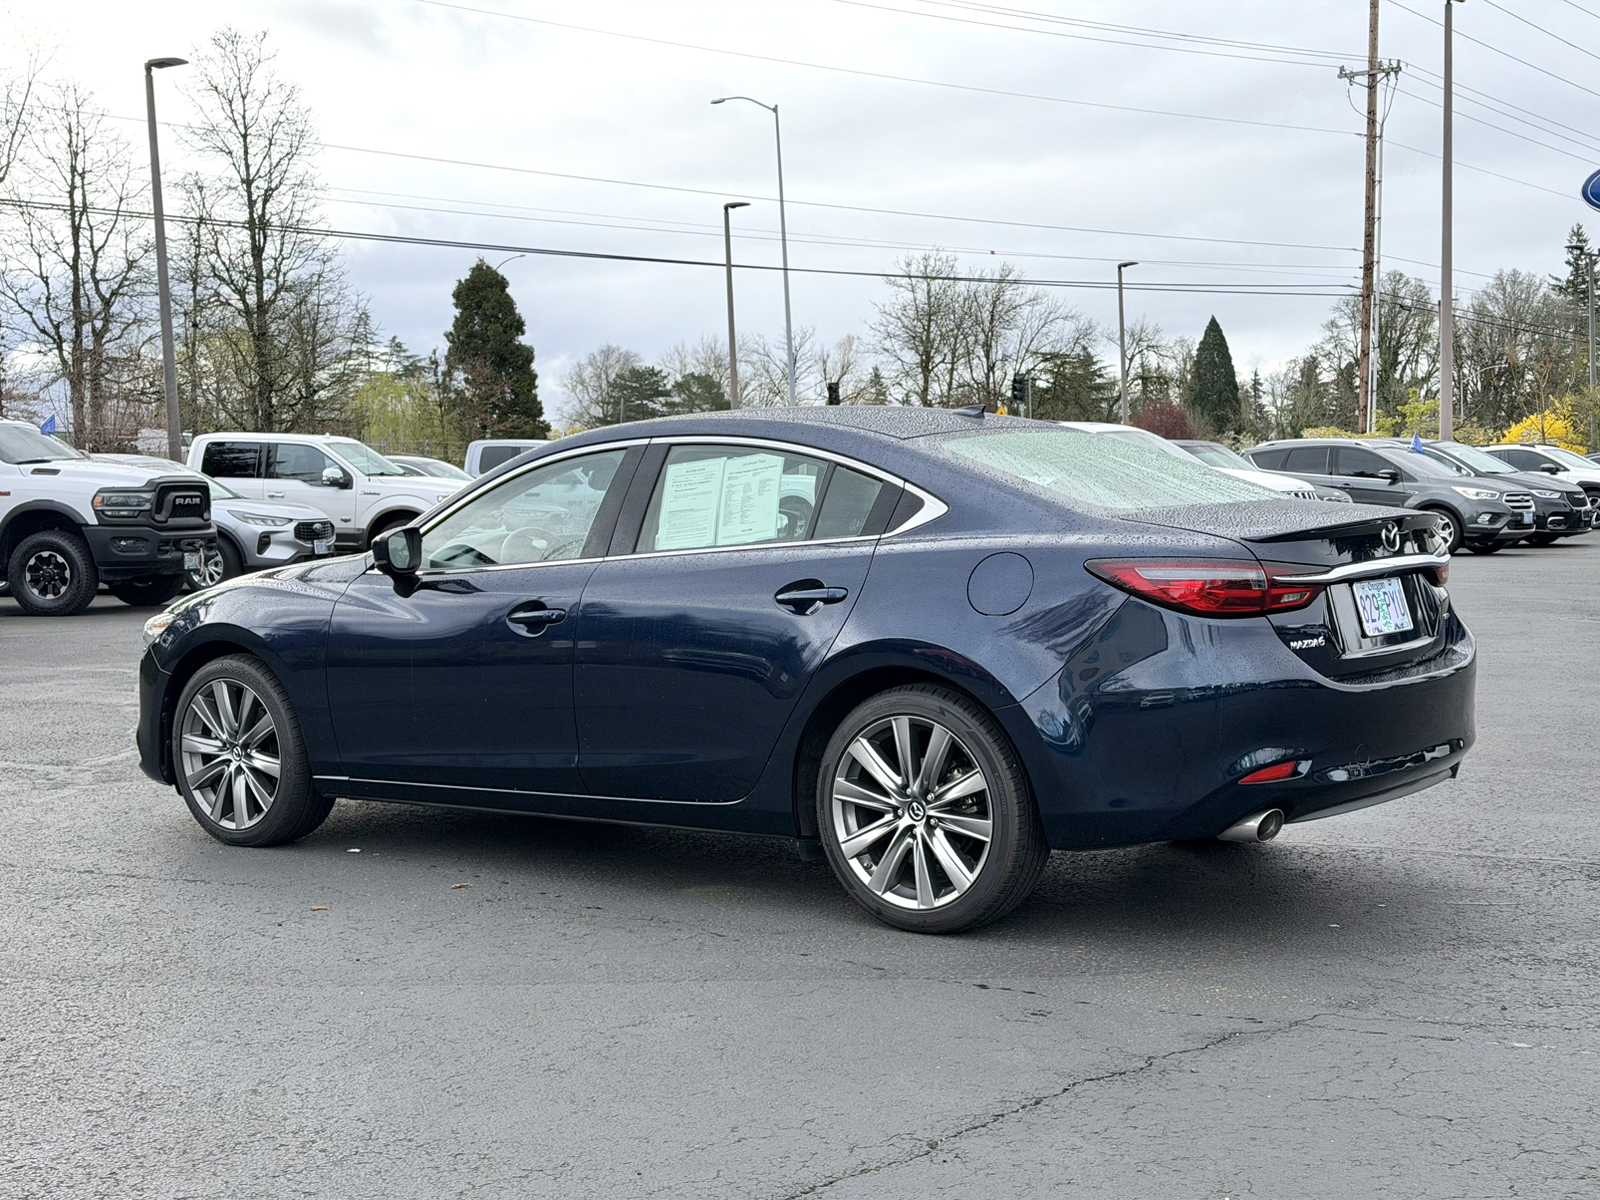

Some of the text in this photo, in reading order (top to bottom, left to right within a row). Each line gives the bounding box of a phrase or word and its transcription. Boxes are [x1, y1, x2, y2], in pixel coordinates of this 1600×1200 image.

[175, 497, 201, 505] RAM
[1367, 581, 1386, 593] Oregon
[1360, 590, 1407, 624] 829 PYU
[1290, 636, 1326, 650] MAZDA6
